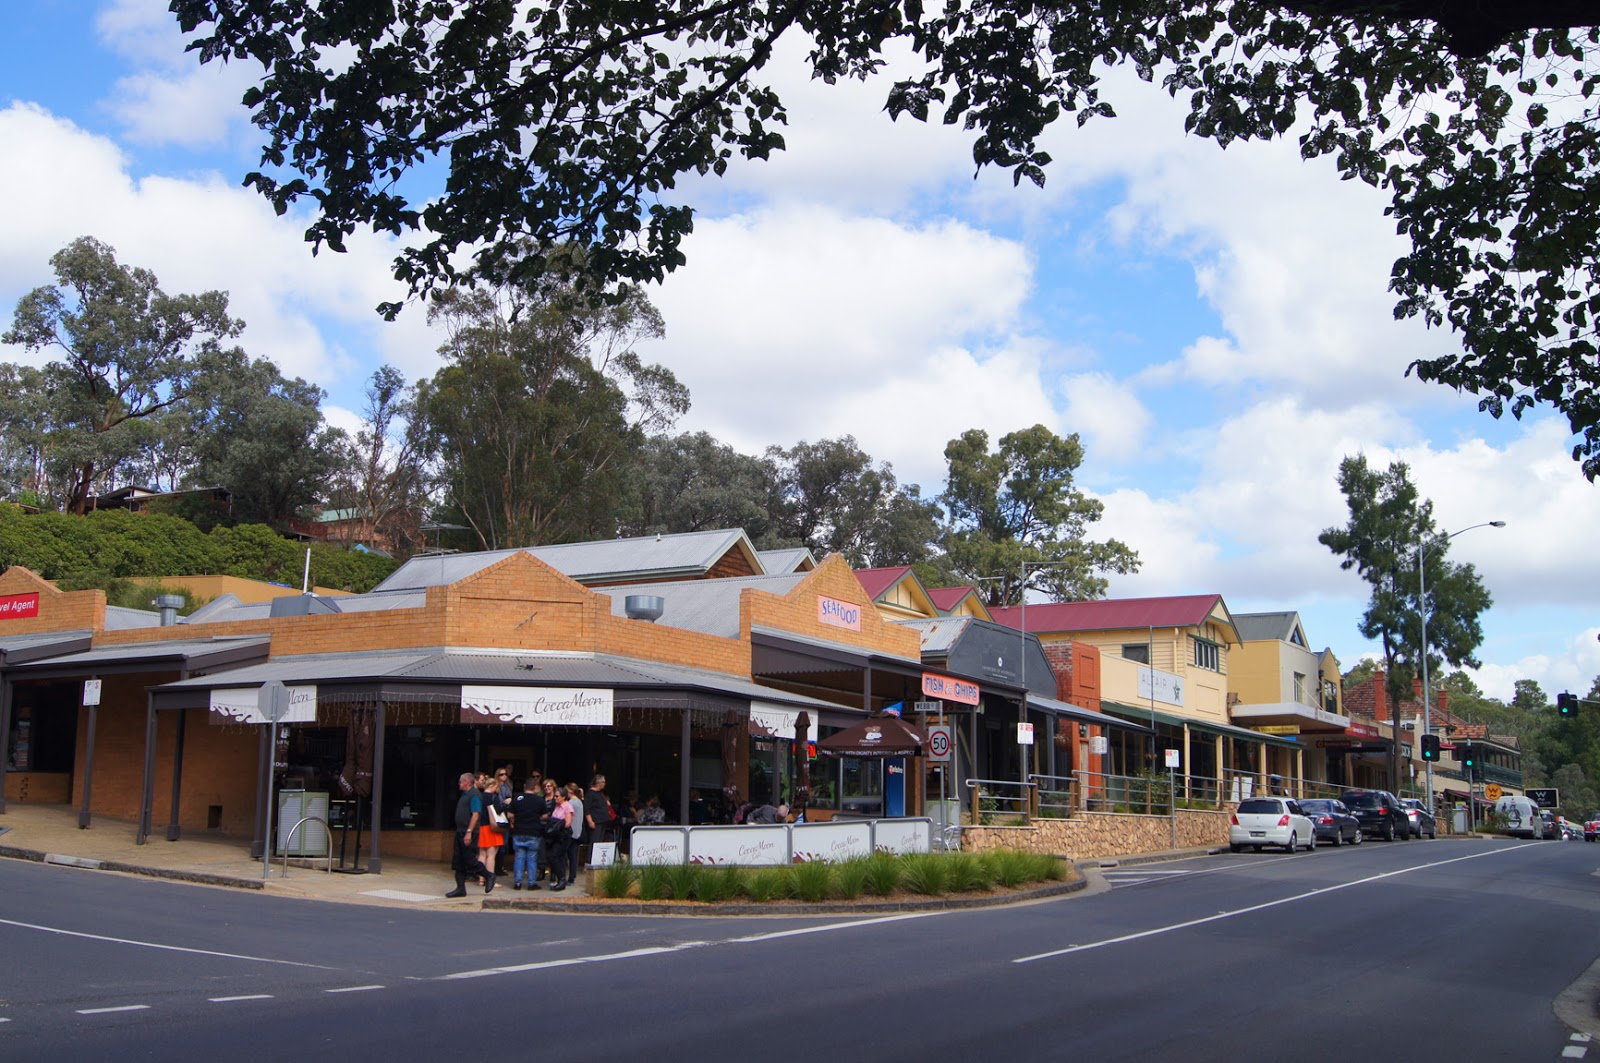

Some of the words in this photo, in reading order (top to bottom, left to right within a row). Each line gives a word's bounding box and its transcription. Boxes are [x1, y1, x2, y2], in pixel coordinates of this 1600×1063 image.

[11, 600, 35, 612] Agent
[822, 600, 857, 624] SEAFOOD
[1141, 673, 1167, 688] ALAIR
[925, 676, 944, 693] FISH
[954, 682, 978, 701] CHIPS
[933, 737, 947, 750] 50
